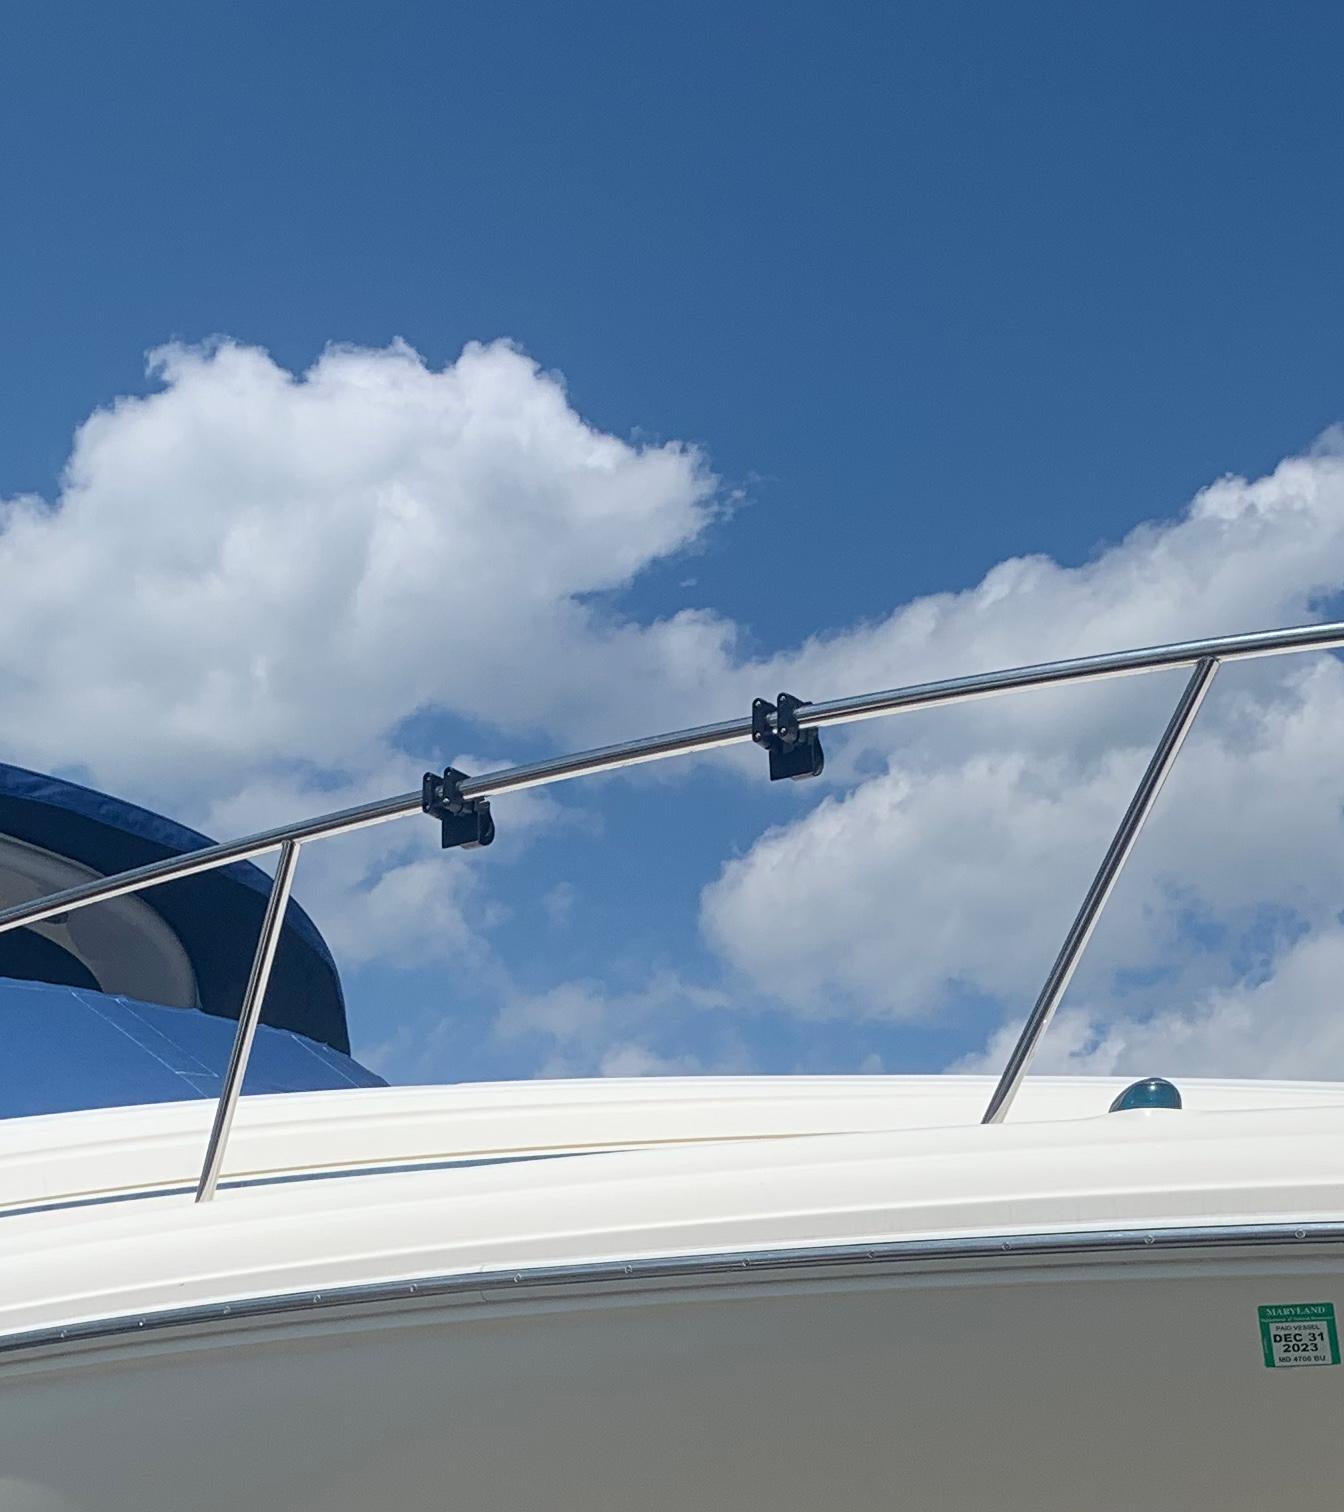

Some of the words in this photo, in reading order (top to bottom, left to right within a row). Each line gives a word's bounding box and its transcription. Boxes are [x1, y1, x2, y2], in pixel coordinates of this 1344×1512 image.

[1266, 1307, 1326, 1316] MARYLAND
[1272, 1333, 1303, 1343] DEC
[1308, 1332, 1325, 1342] 31
[1282, 1342, 1319, 1353] 2023
